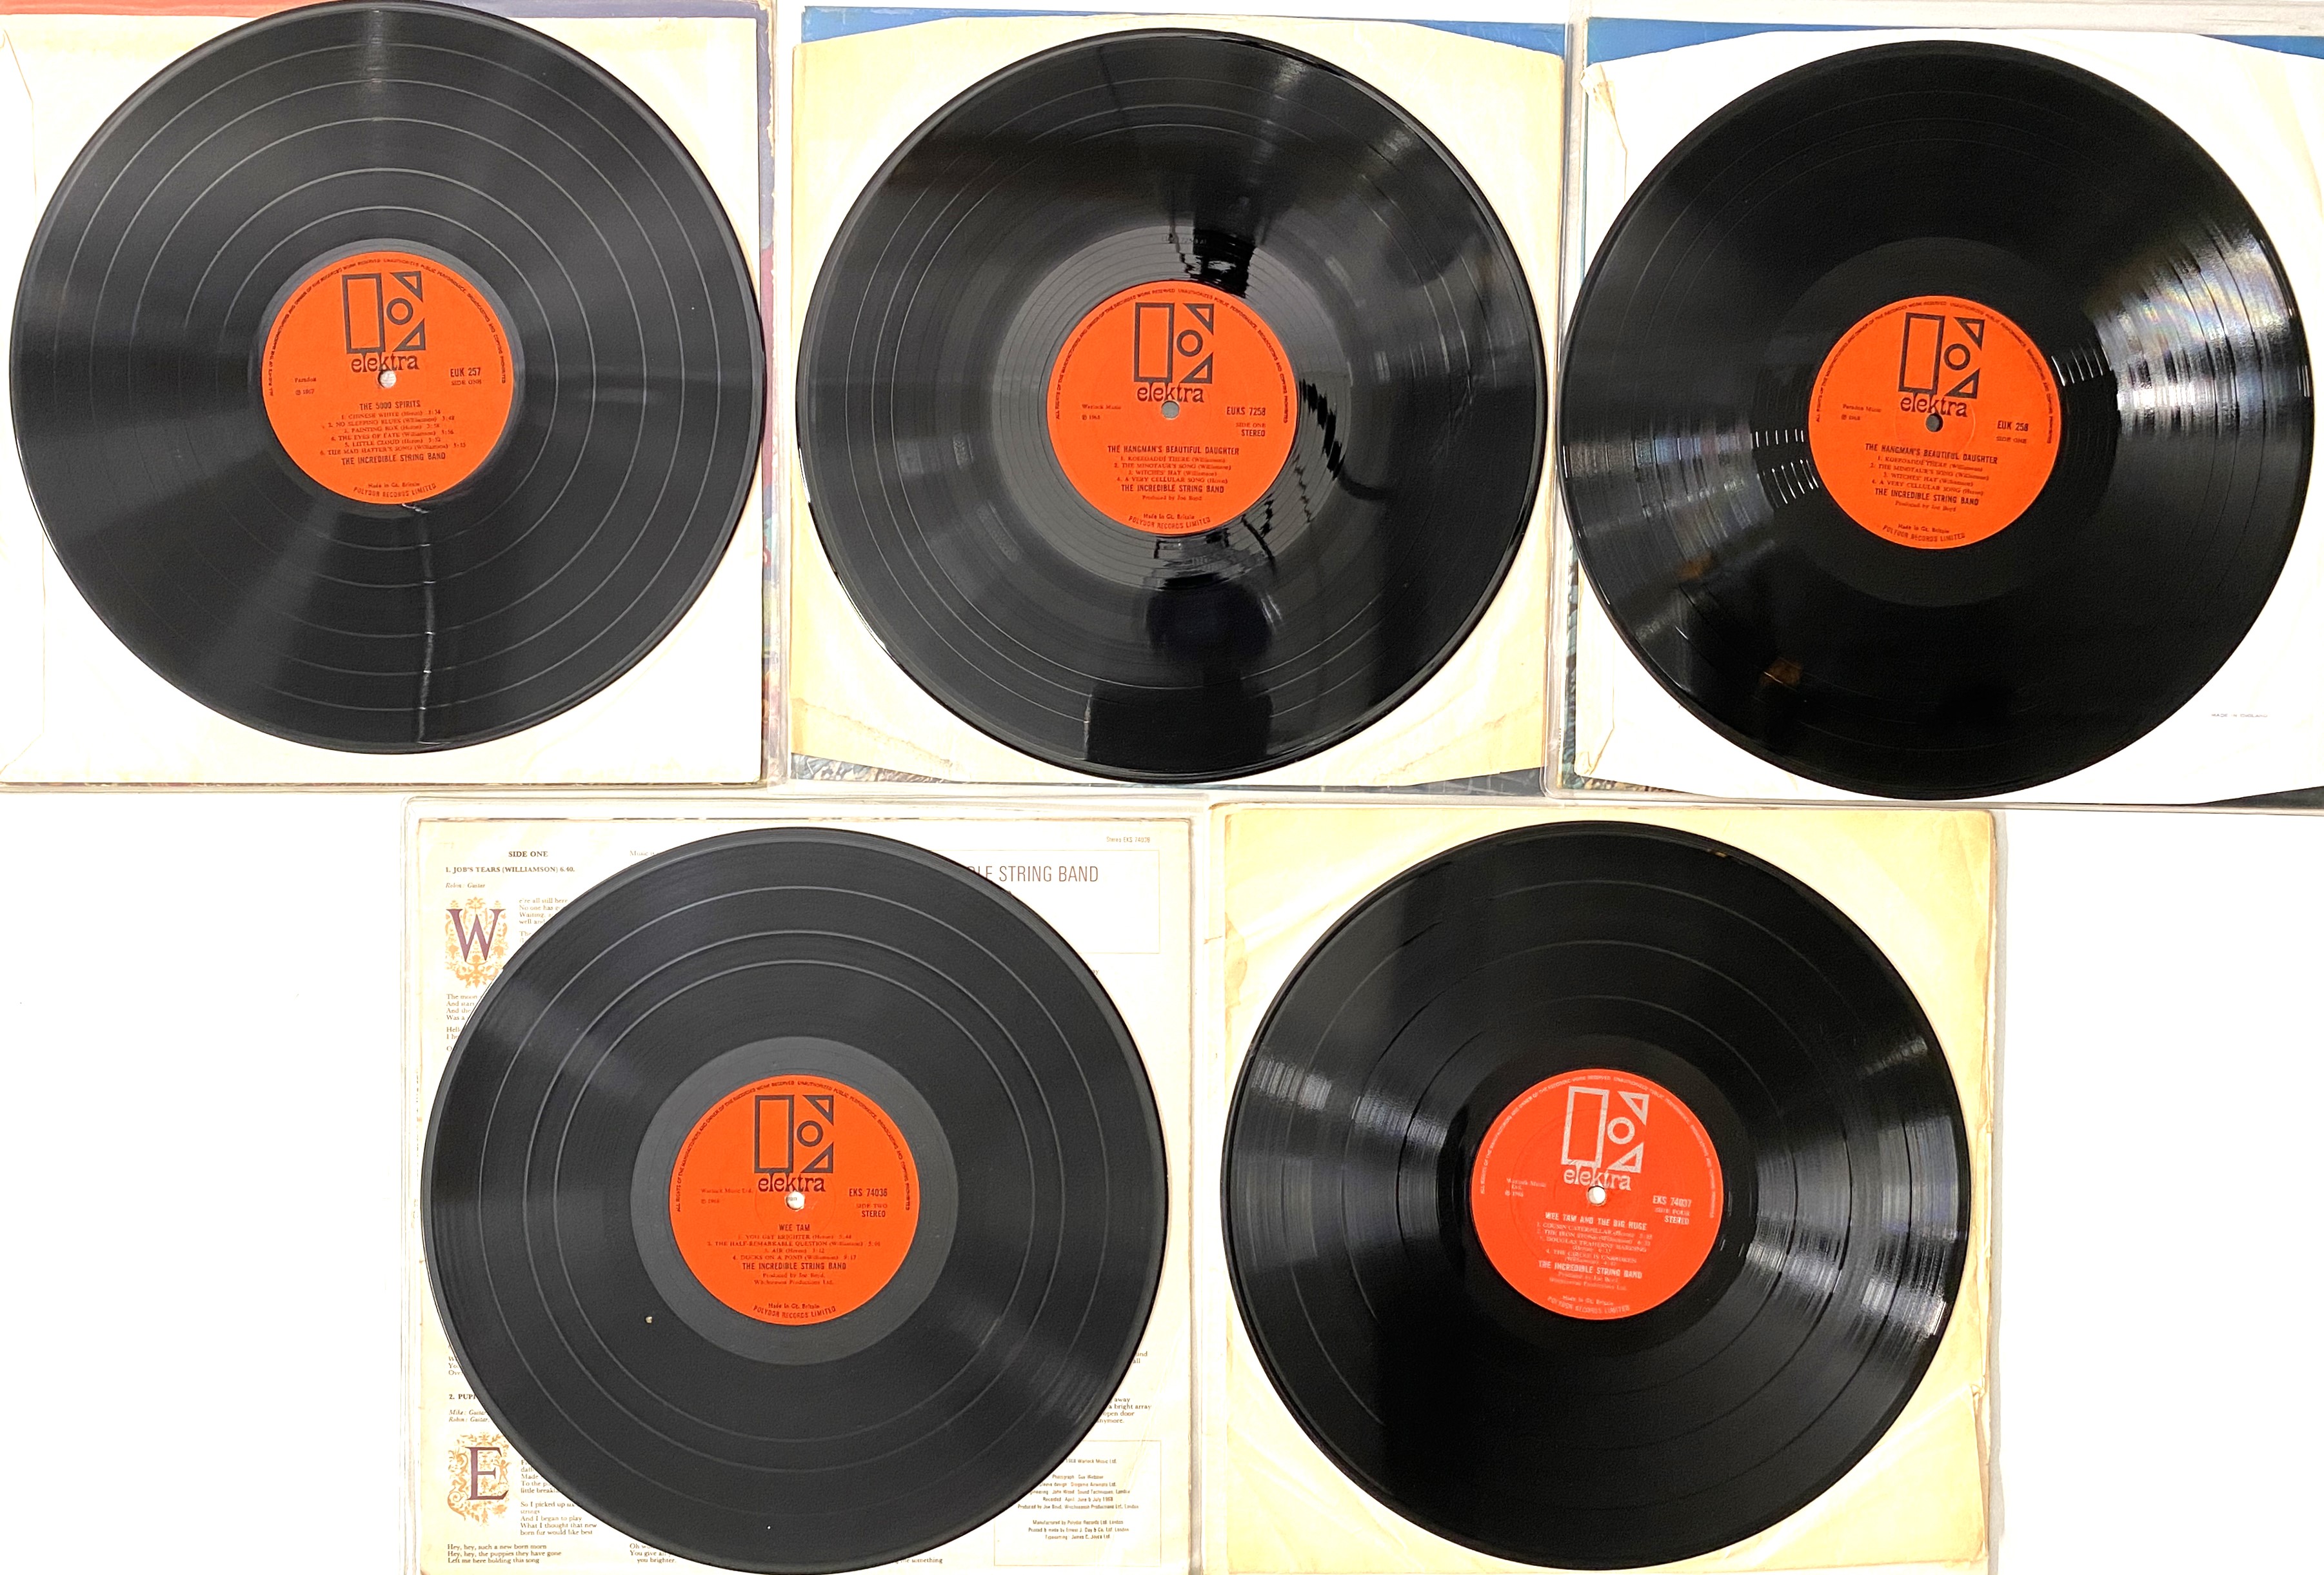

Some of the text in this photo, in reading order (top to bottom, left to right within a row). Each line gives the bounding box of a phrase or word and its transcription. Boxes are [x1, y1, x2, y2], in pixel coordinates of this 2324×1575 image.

[351, 353, 419, 372] elektra
[450, 367, 481, 377] EUK 257
[1137, 384, 1204, 402] elektra
[395, 400, 421, 408] SPIRITS
[1227, 406, 1266, 415] EUKS 7258
[1900, 393, 1968, 417] elektra
[1998, 421, 2029, 431] EUK 258
[358, 455, 396, 464] INCREDIBLE
[400, 453, 424, 462] STRING
[1882, 445, 1920, 455] HANGMAN'S
[1923, 450, 1960, 460] BEAUTIFUL
[1963, 454, 1998, 464] DAUGHTER
[353, 487, 380, 497] POLYDOR
[412, 483, 437, 495] LIMITED
[1891, 490, 1929, 500] INCREDIBLE
[1933, 495, 1957, 504] STRING
[1961, 497, 1979, 506] BAND
[1129, 516, 1154, 528] POLYDOR
[1186, 517, 1211, 528] LIMITED
[1940, 533, 1965, 542] LIMITED
[999, 866, 1098, 882] STRING BAND
[446, 909, 506, 962] W
[758, 1173, 826, 1193] elektra
[1564, 1165, 1631, 1191] elektra
[849, 1188, 888, 1196] EKS 74036
[1653, 1195, 1692, 1207] EKS 74037
[1545, 1212, 1559, 1220] WEE
[1563, 1214, 1576, 1222] TAM
[1580, 1216, 1593, 1224] AND
[1598, 1218, 1611, 1226] THE
[1628, 1221, 1647, 1231] HUGE
[1665, 1215, 1689, 1225] STEREO
[1554, 1262, 1593, 1274] INCREDIBLE
[1596, 1267, 1620, 1277] STRING
[1624, 1270, 1642, 1279] BAND
[753, 1305, 779, 1318] POLYDOR
[811, 1305, 836, 1317] LIMITED
[465, 1446, 509, 1501] E
